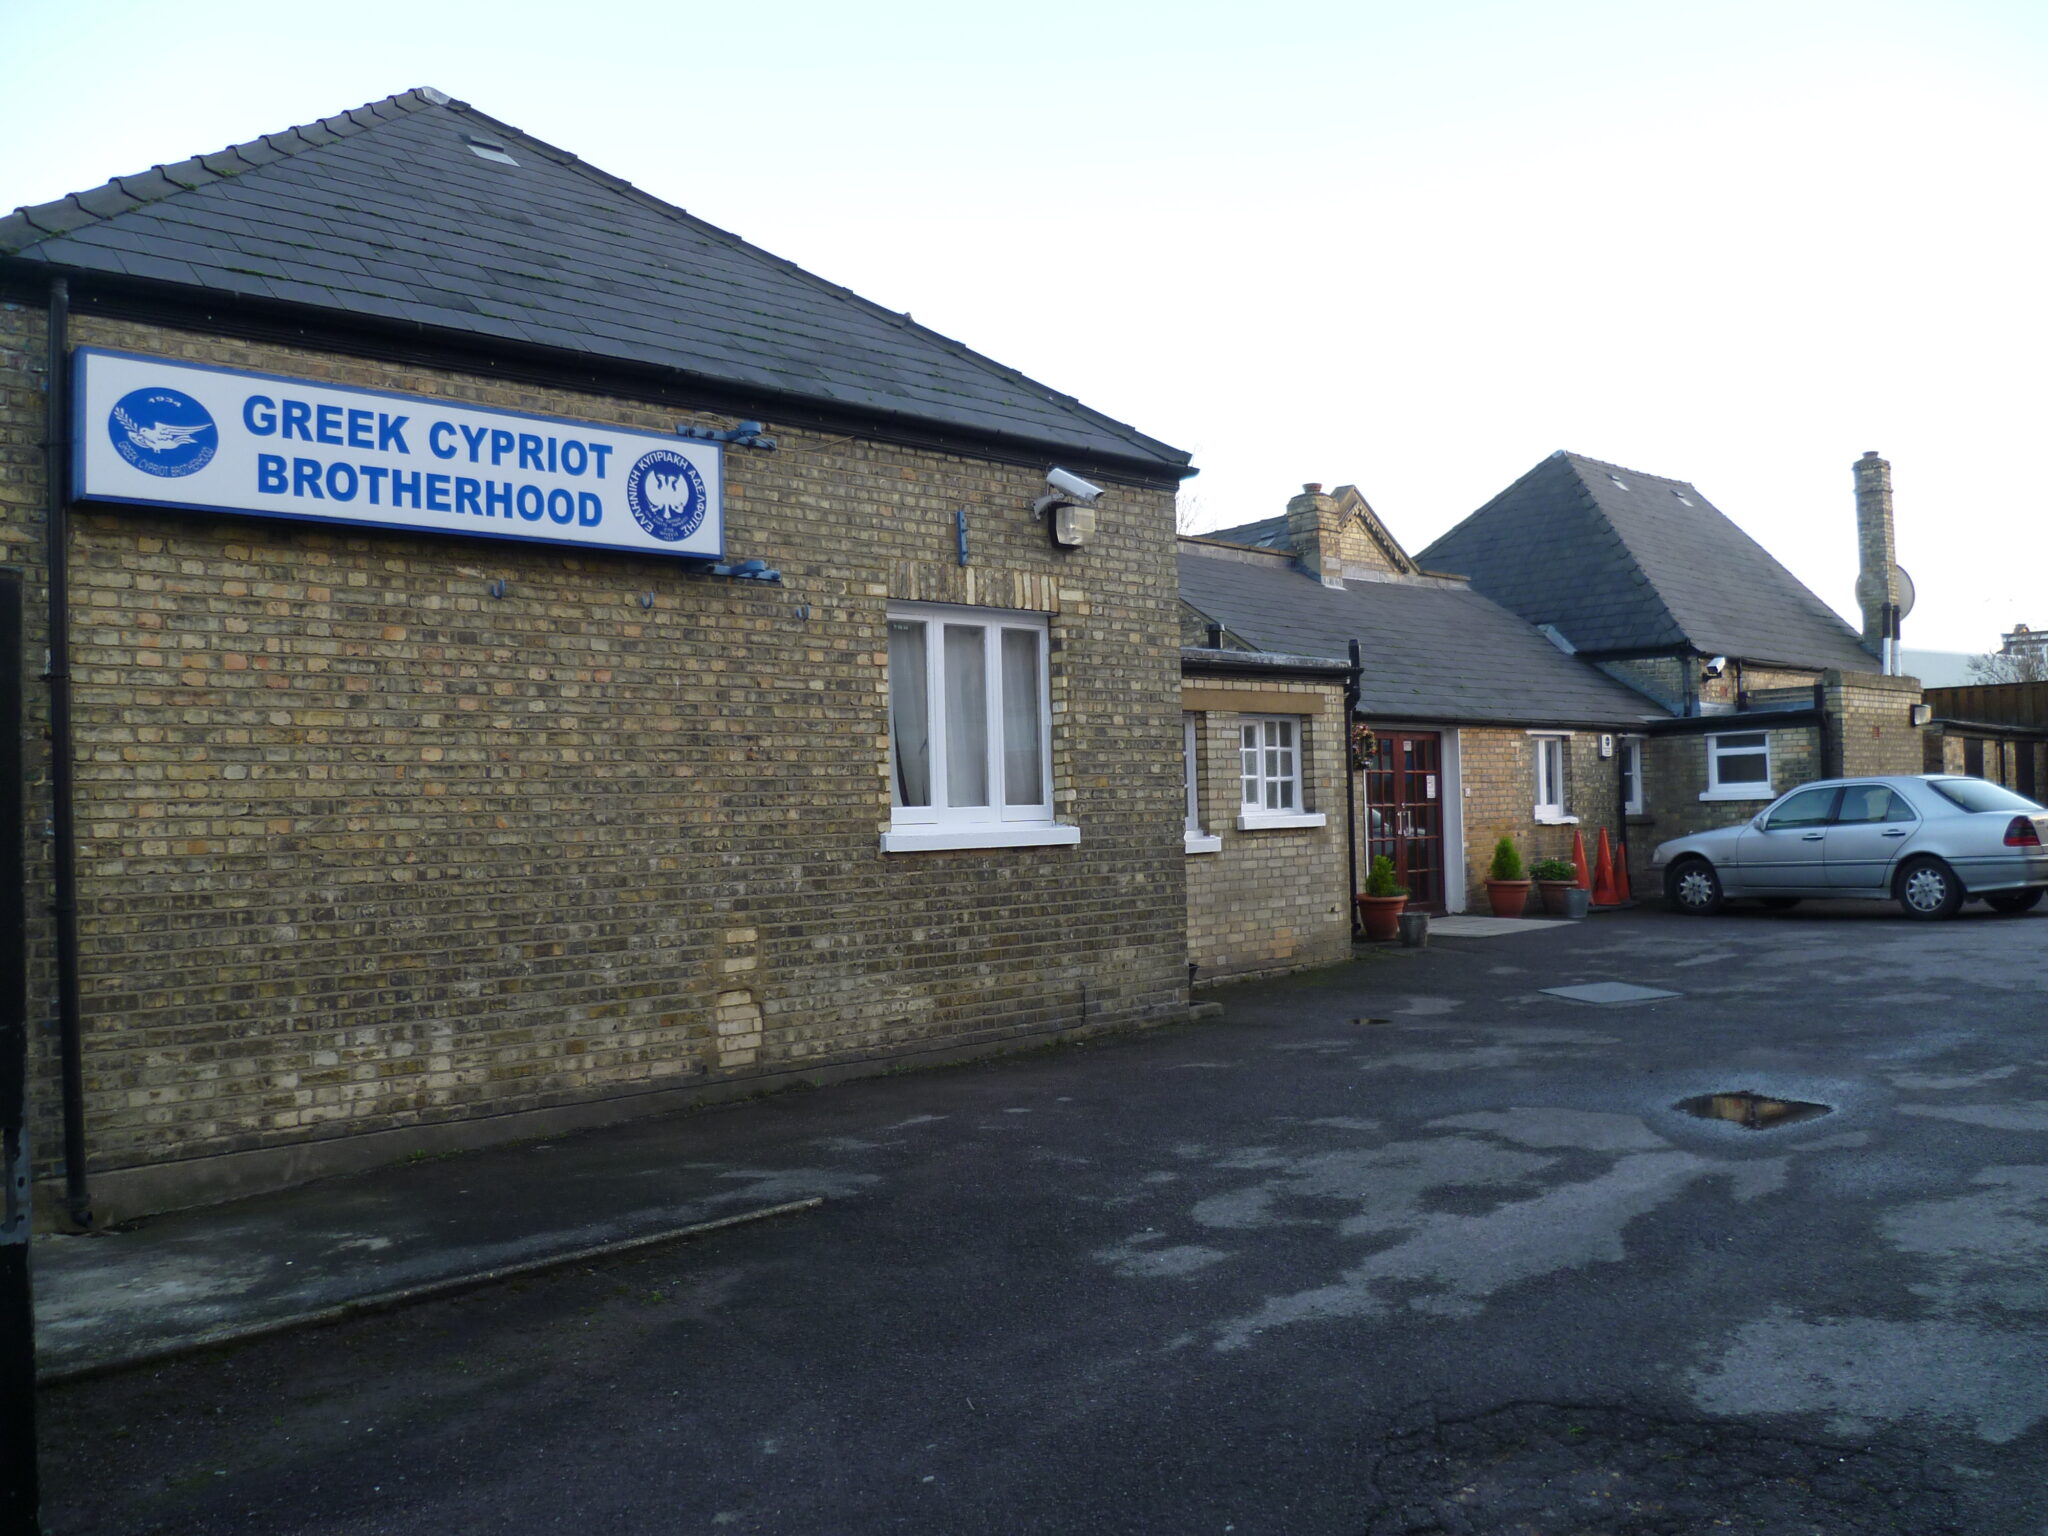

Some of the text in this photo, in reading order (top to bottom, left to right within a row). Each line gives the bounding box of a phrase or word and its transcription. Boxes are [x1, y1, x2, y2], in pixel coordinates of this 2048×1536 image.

[242, 395, 613, 479] GREEK CYPRIOT
[638, 452, 688, 471] ΚΥΠΡΙΑΚΗ
[257, 454, 603, 527] BROTHERHOOD
